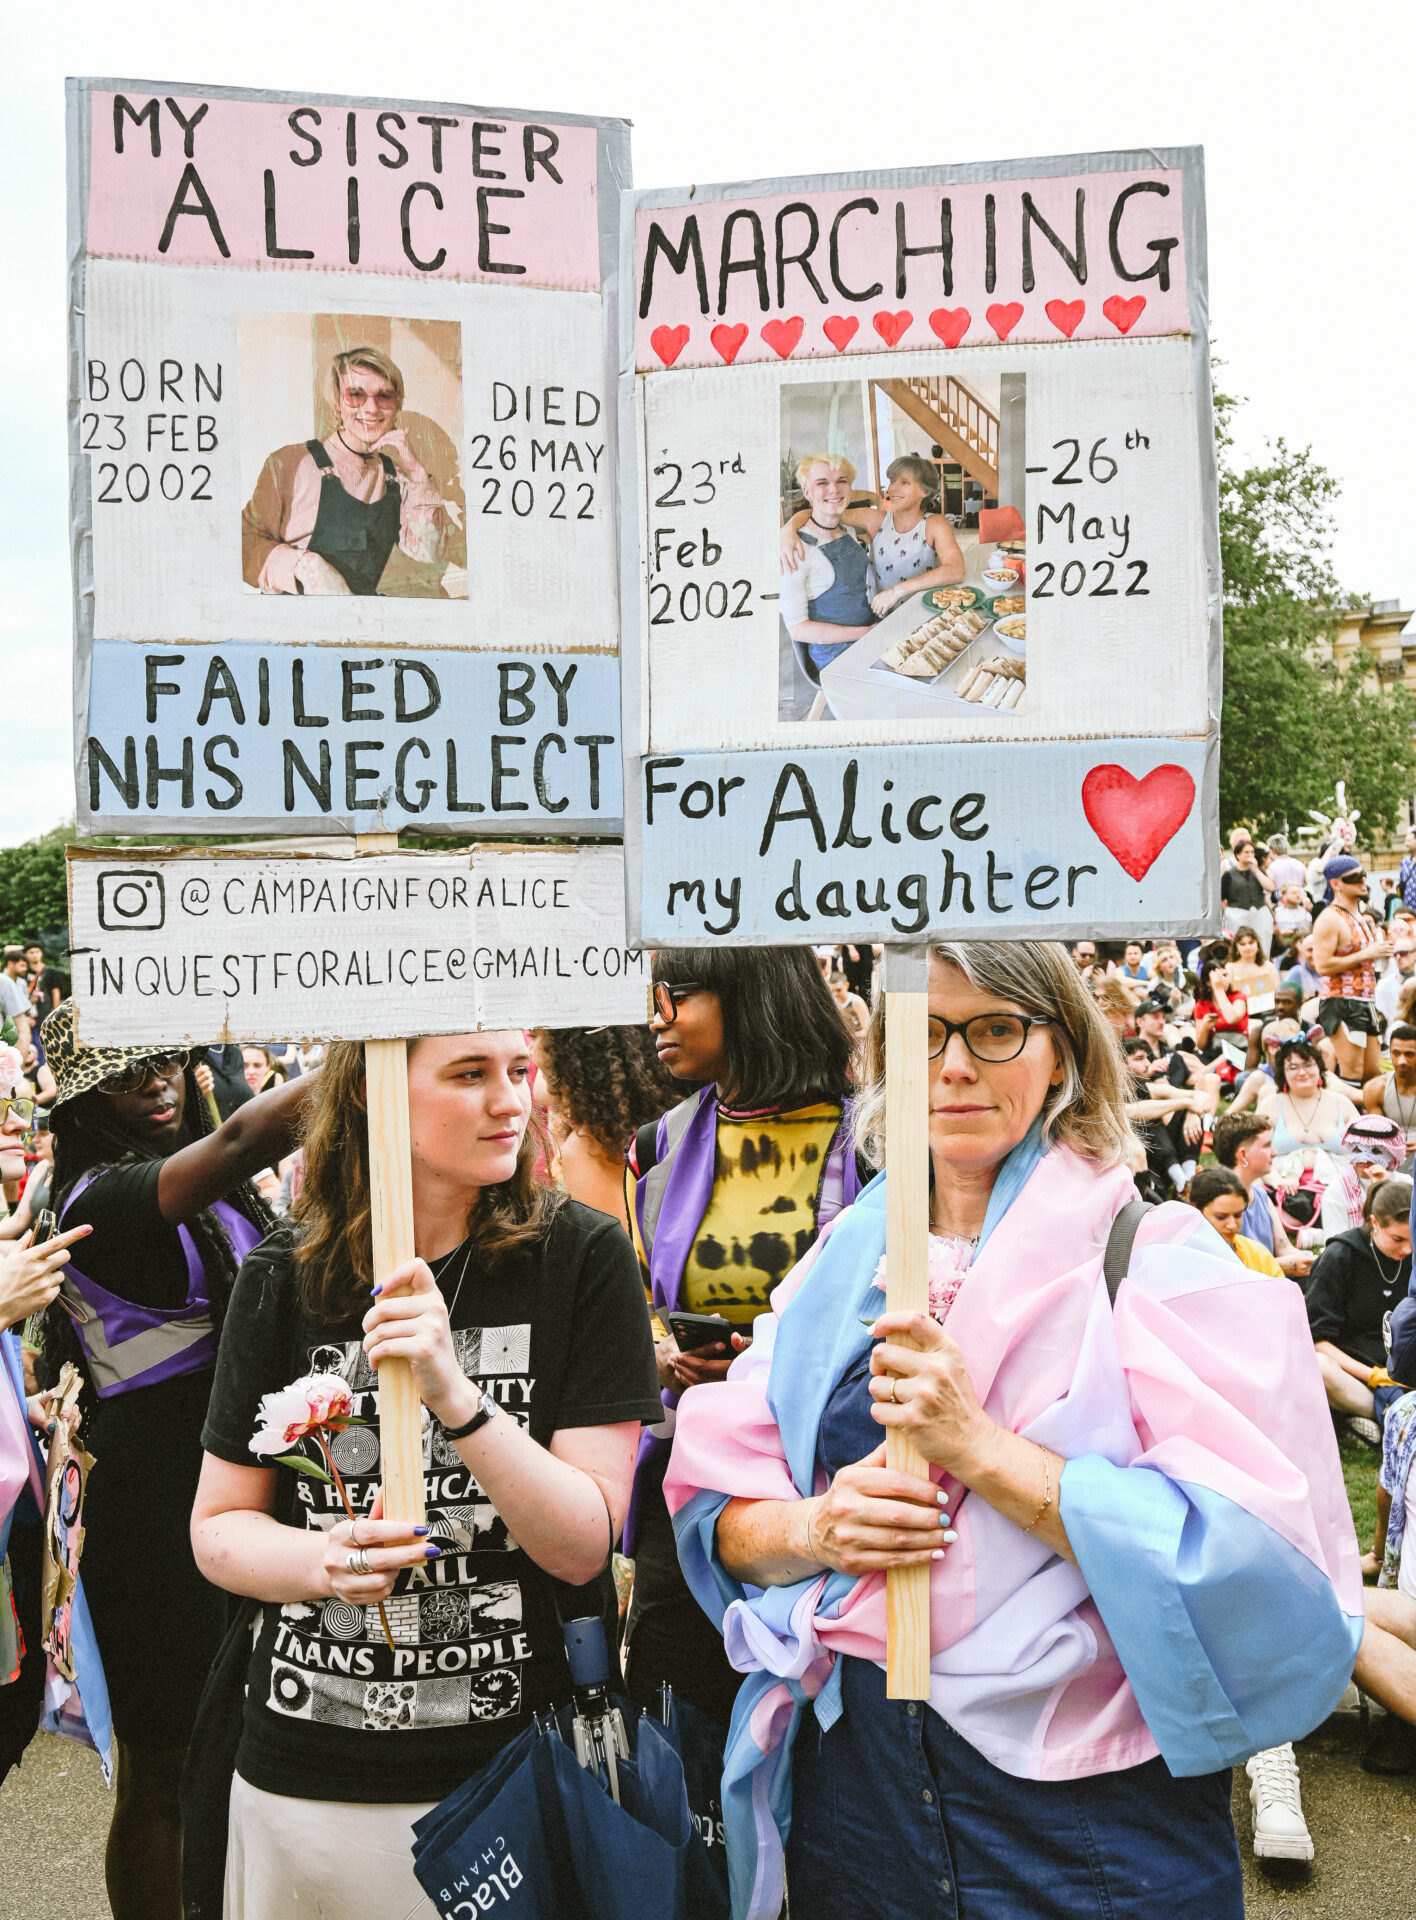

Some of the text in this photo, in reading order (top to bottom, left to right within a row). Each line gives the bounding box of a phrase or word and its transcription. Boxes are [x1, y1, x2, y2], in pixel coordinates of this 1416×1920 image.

[113, 93, 564, 185] MY SISTER
[157, 162, 527, 274] ALICE
[638, 180, 1180, 318] MARCHING
[87, 358, 223, 402] BORN
[492, 382, 600, 427] DIED
[82, 413, 219, 453] 23 FEB
[471, 434, 605, 474] 26 MAY
[97, 463, 214, 503] 2002
[480, 478, 596, 520] 2022
[652, 526, 723, 573] Feb
[1037, 502, 1131, 558] May
[1031, 560, 1151, 599] 2022
[145, 654, 578, 728] FAILED BY
[87, 732, 615, 814] NHS NEGLECT
[645, 756, 990, 857] For Alice
[666, 848, 1098, 936] my daughter
[404, 1556, 478, 1590] ALL
[273, 1620, 534, 1677] TRANS PEOPLE
